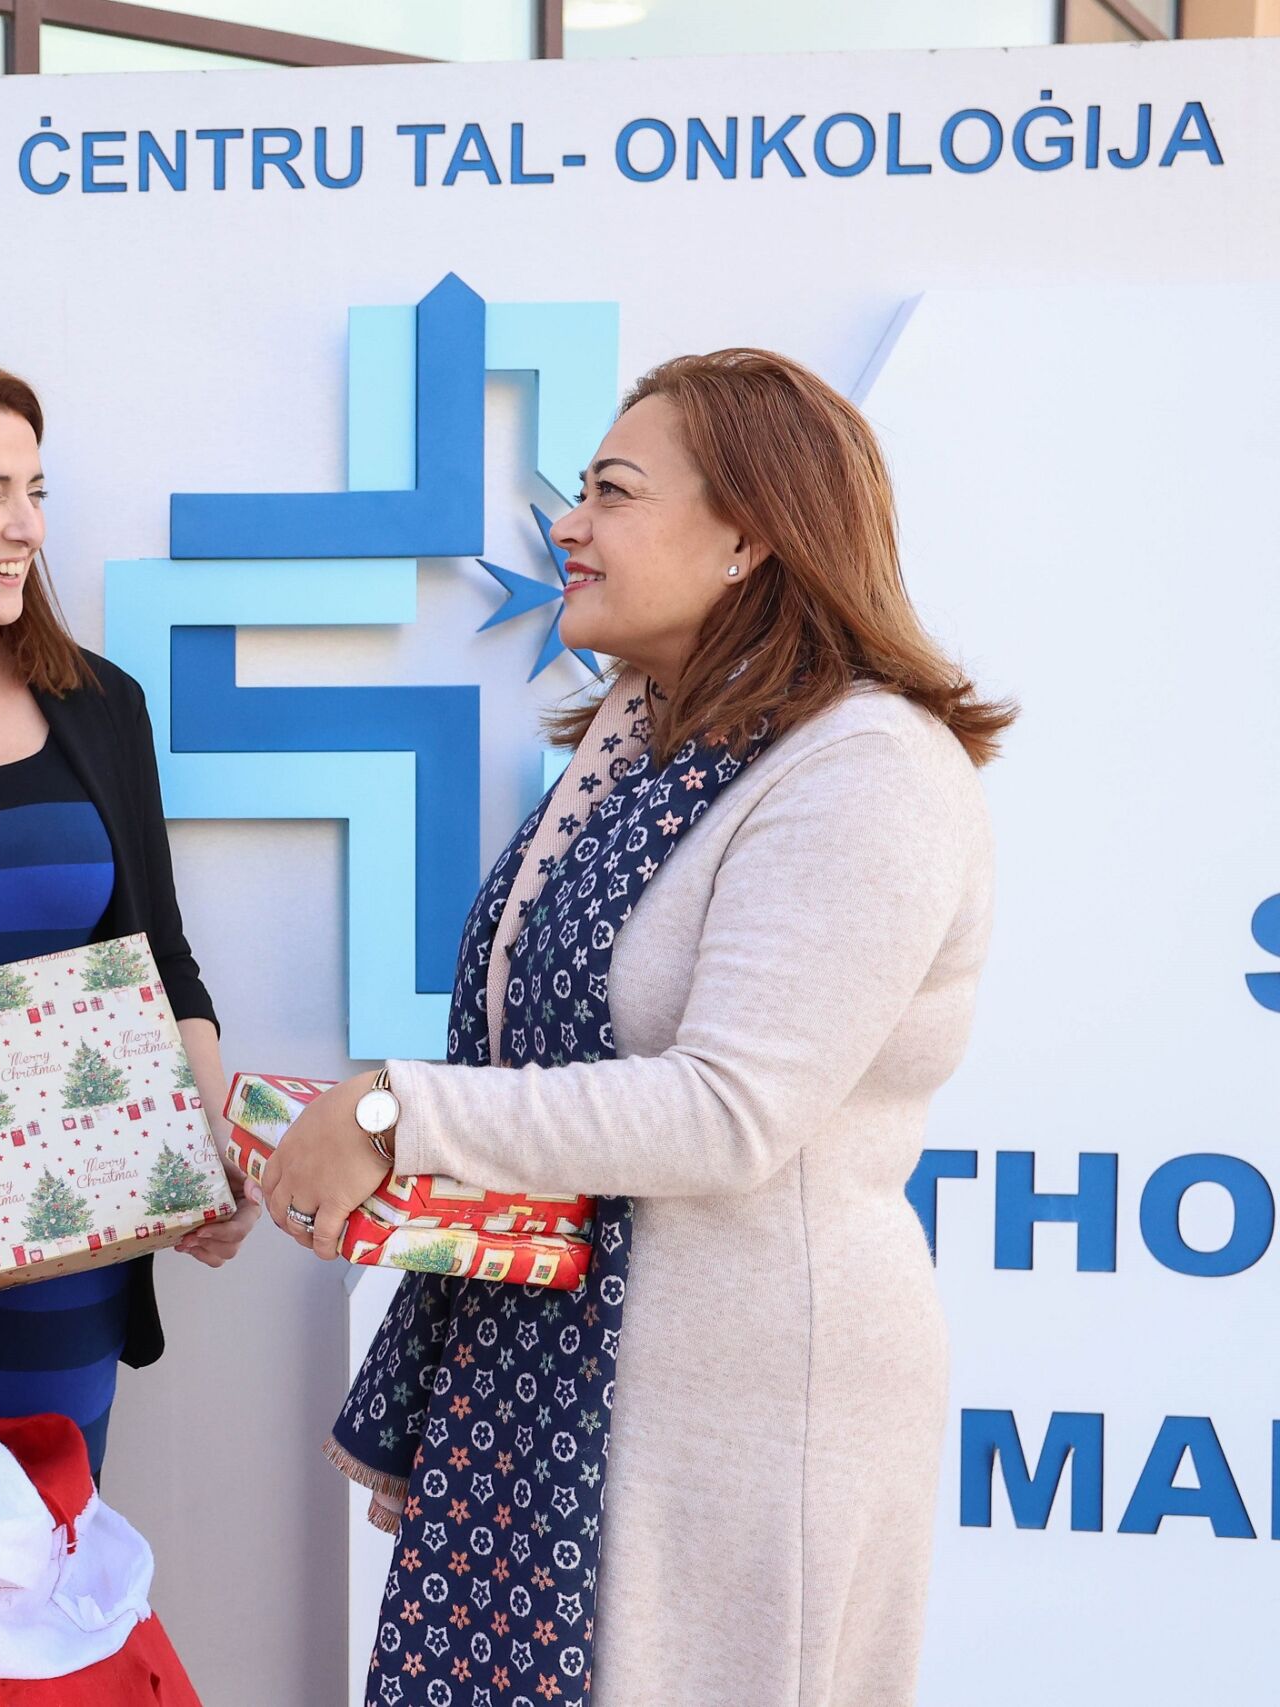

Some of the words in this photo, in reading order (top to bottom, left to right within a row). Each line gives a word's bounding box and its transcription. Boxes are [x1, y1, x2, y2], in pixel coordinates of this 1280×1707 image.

[19, 116, 363, 196] ĊENTRU
[396, 122, 587, 188] TAL-
[615, 89, 1224, 183] ONKOLOĠIJA
[119, 1029, 161, 1044] Merry
[8, 1051, 52, 1067] Merry
[113, 1040, 174, 1060] Christmas
[1, 1063, 62, 1082] Christmas
[83, 1156, 127, 1172] Merry
[76, 1169, 139, 1189] Christmas
[959, 1407, 1280, 1541] MA
